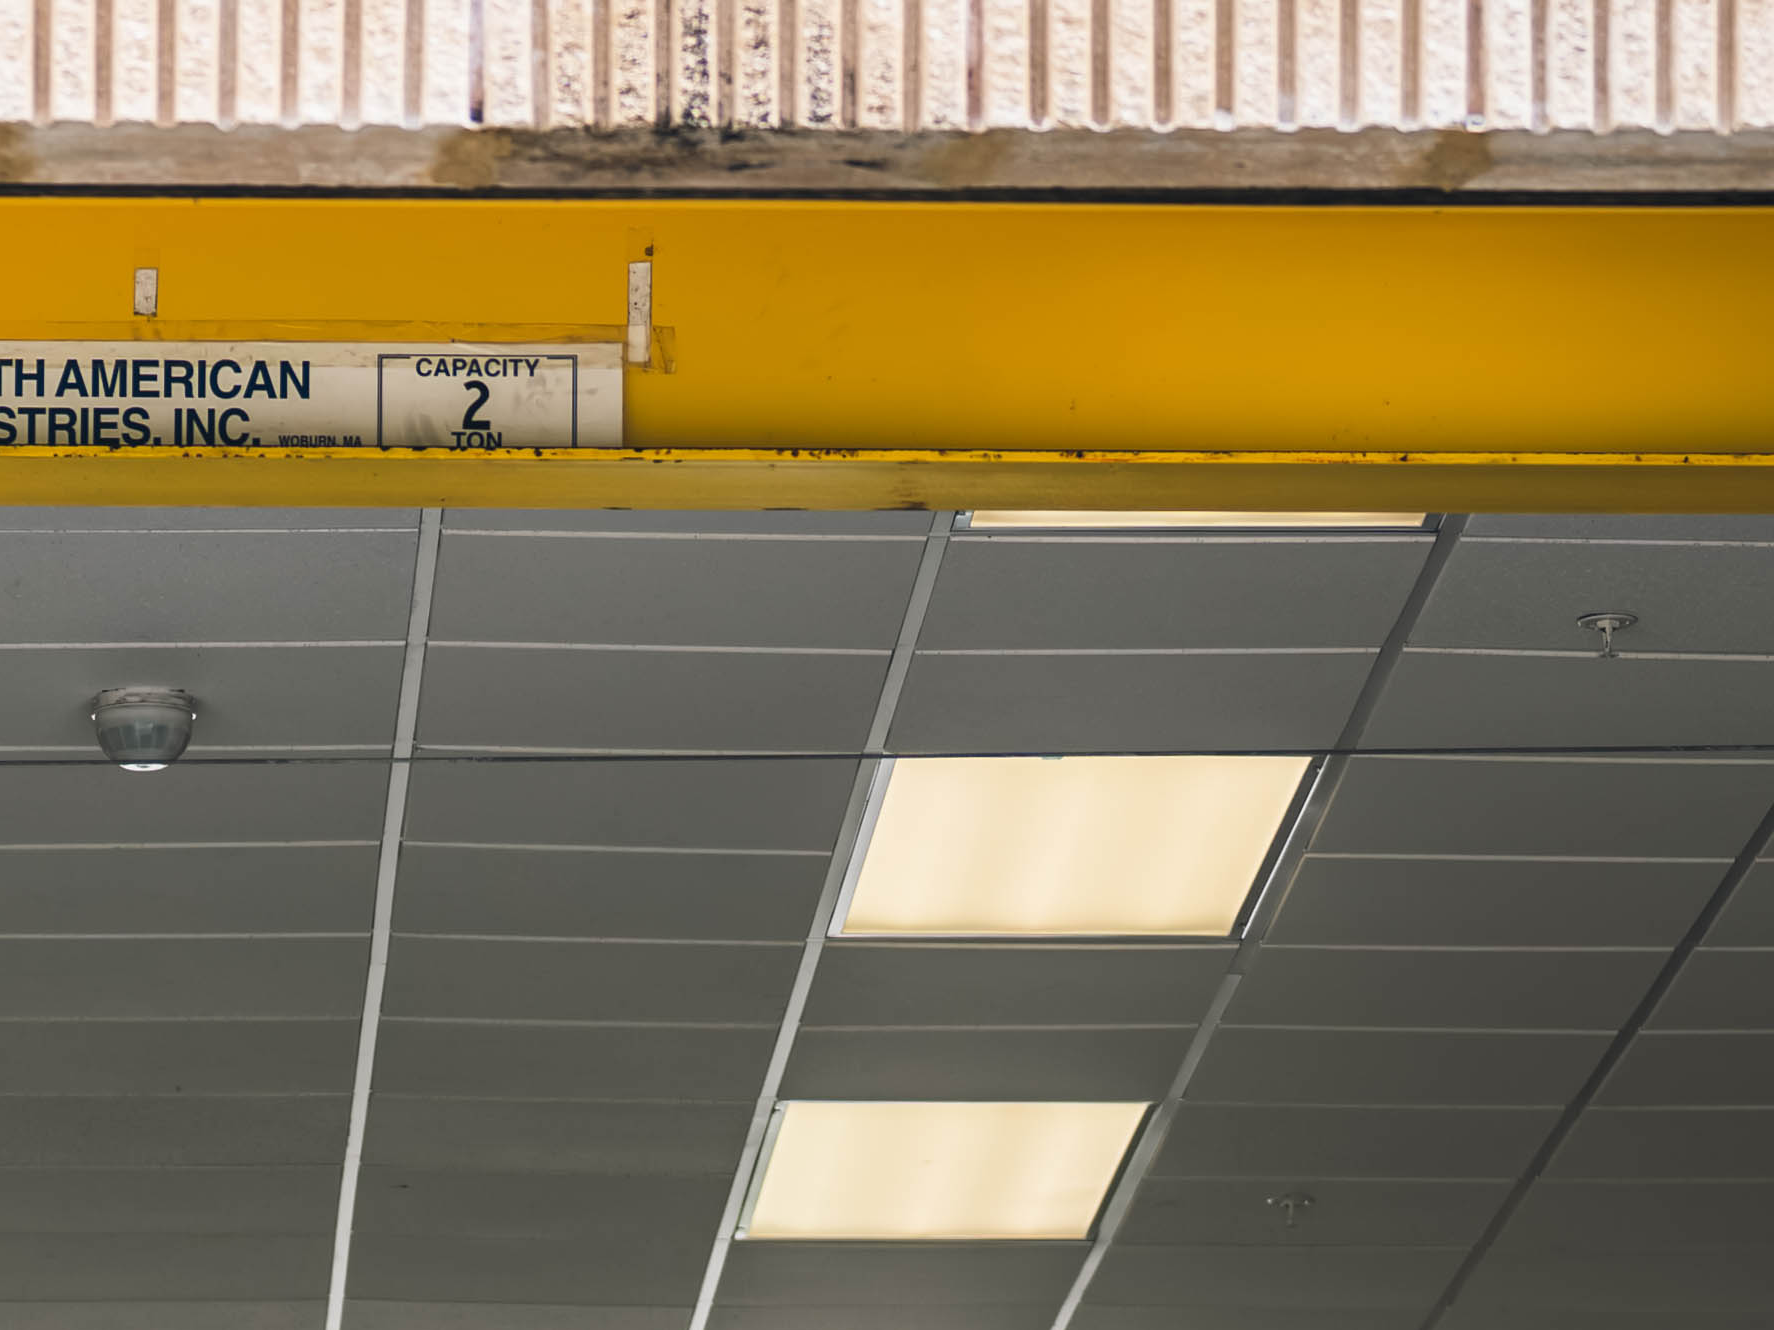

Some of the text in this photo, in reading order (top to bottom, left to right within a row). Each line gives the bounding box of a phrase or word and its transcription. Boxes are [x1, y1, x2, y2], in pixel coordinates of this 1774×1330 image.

[54, 358, 311, 400] AMERICAN
[415, 357, 540, 377] CAPACITY
[461, 380, 491, 431] 2
[173, 407, 262, 447] INC.
[342, 434, 362, 447] MA
[450, 431, 503, 449] TON
